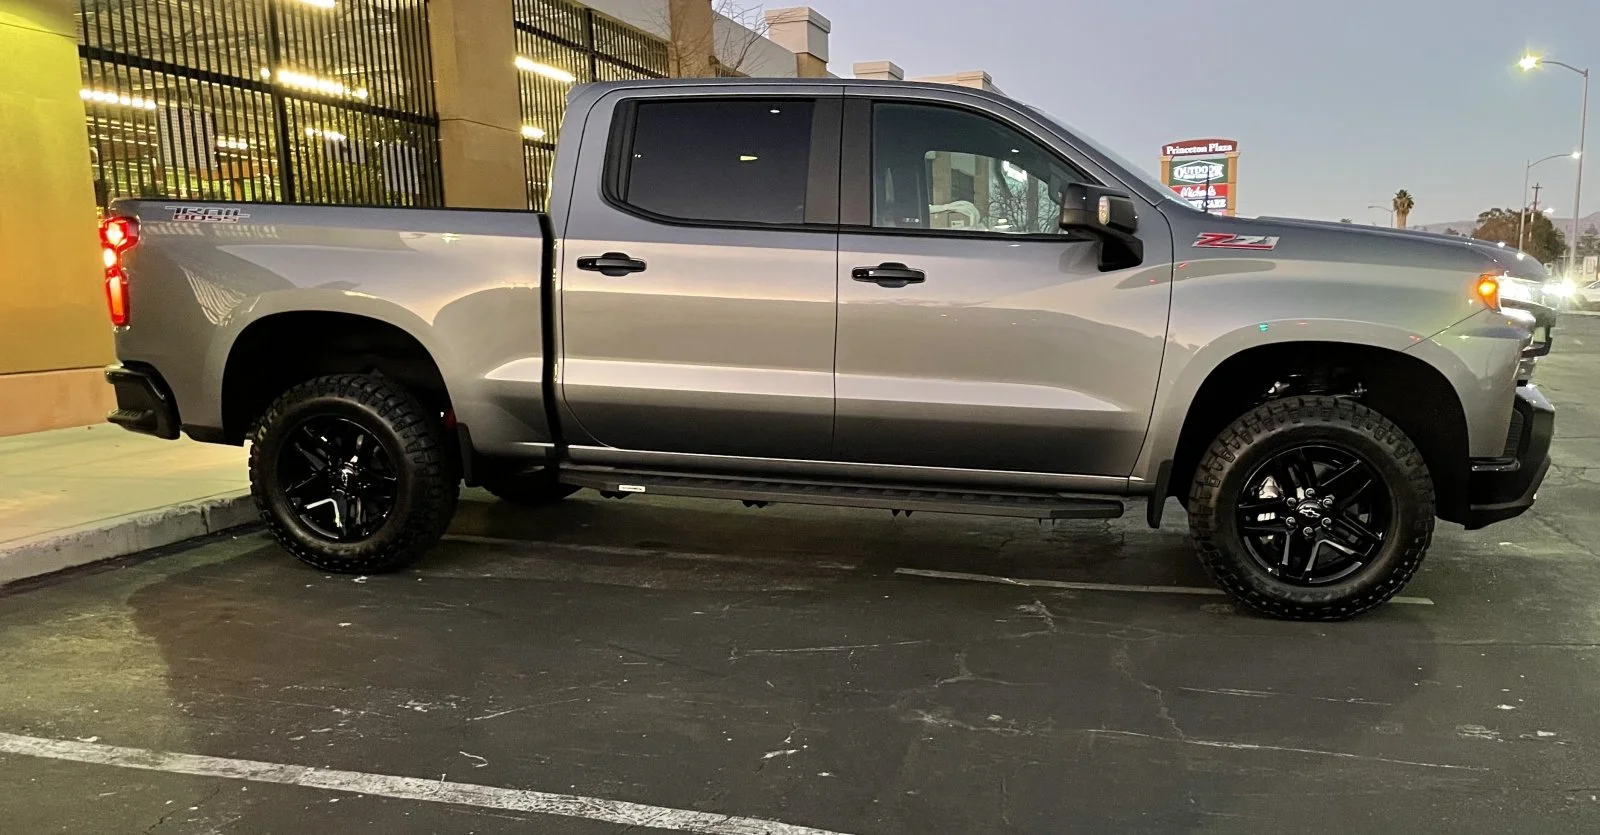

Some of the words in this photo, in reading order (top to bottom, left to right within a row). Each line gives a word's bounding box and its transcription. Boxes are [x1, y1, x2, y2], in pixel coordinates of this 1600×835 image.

[1166, 145, 1207, 155] Princeton
[1208, 143, 1233, 152] Plaza
[1180, 185, 1216, 197] Michals
[165, 206, 251, 218] TRAIL
[172, 214, 240, 223] BOSS
[1192, 232, 1280, 250] Z71
